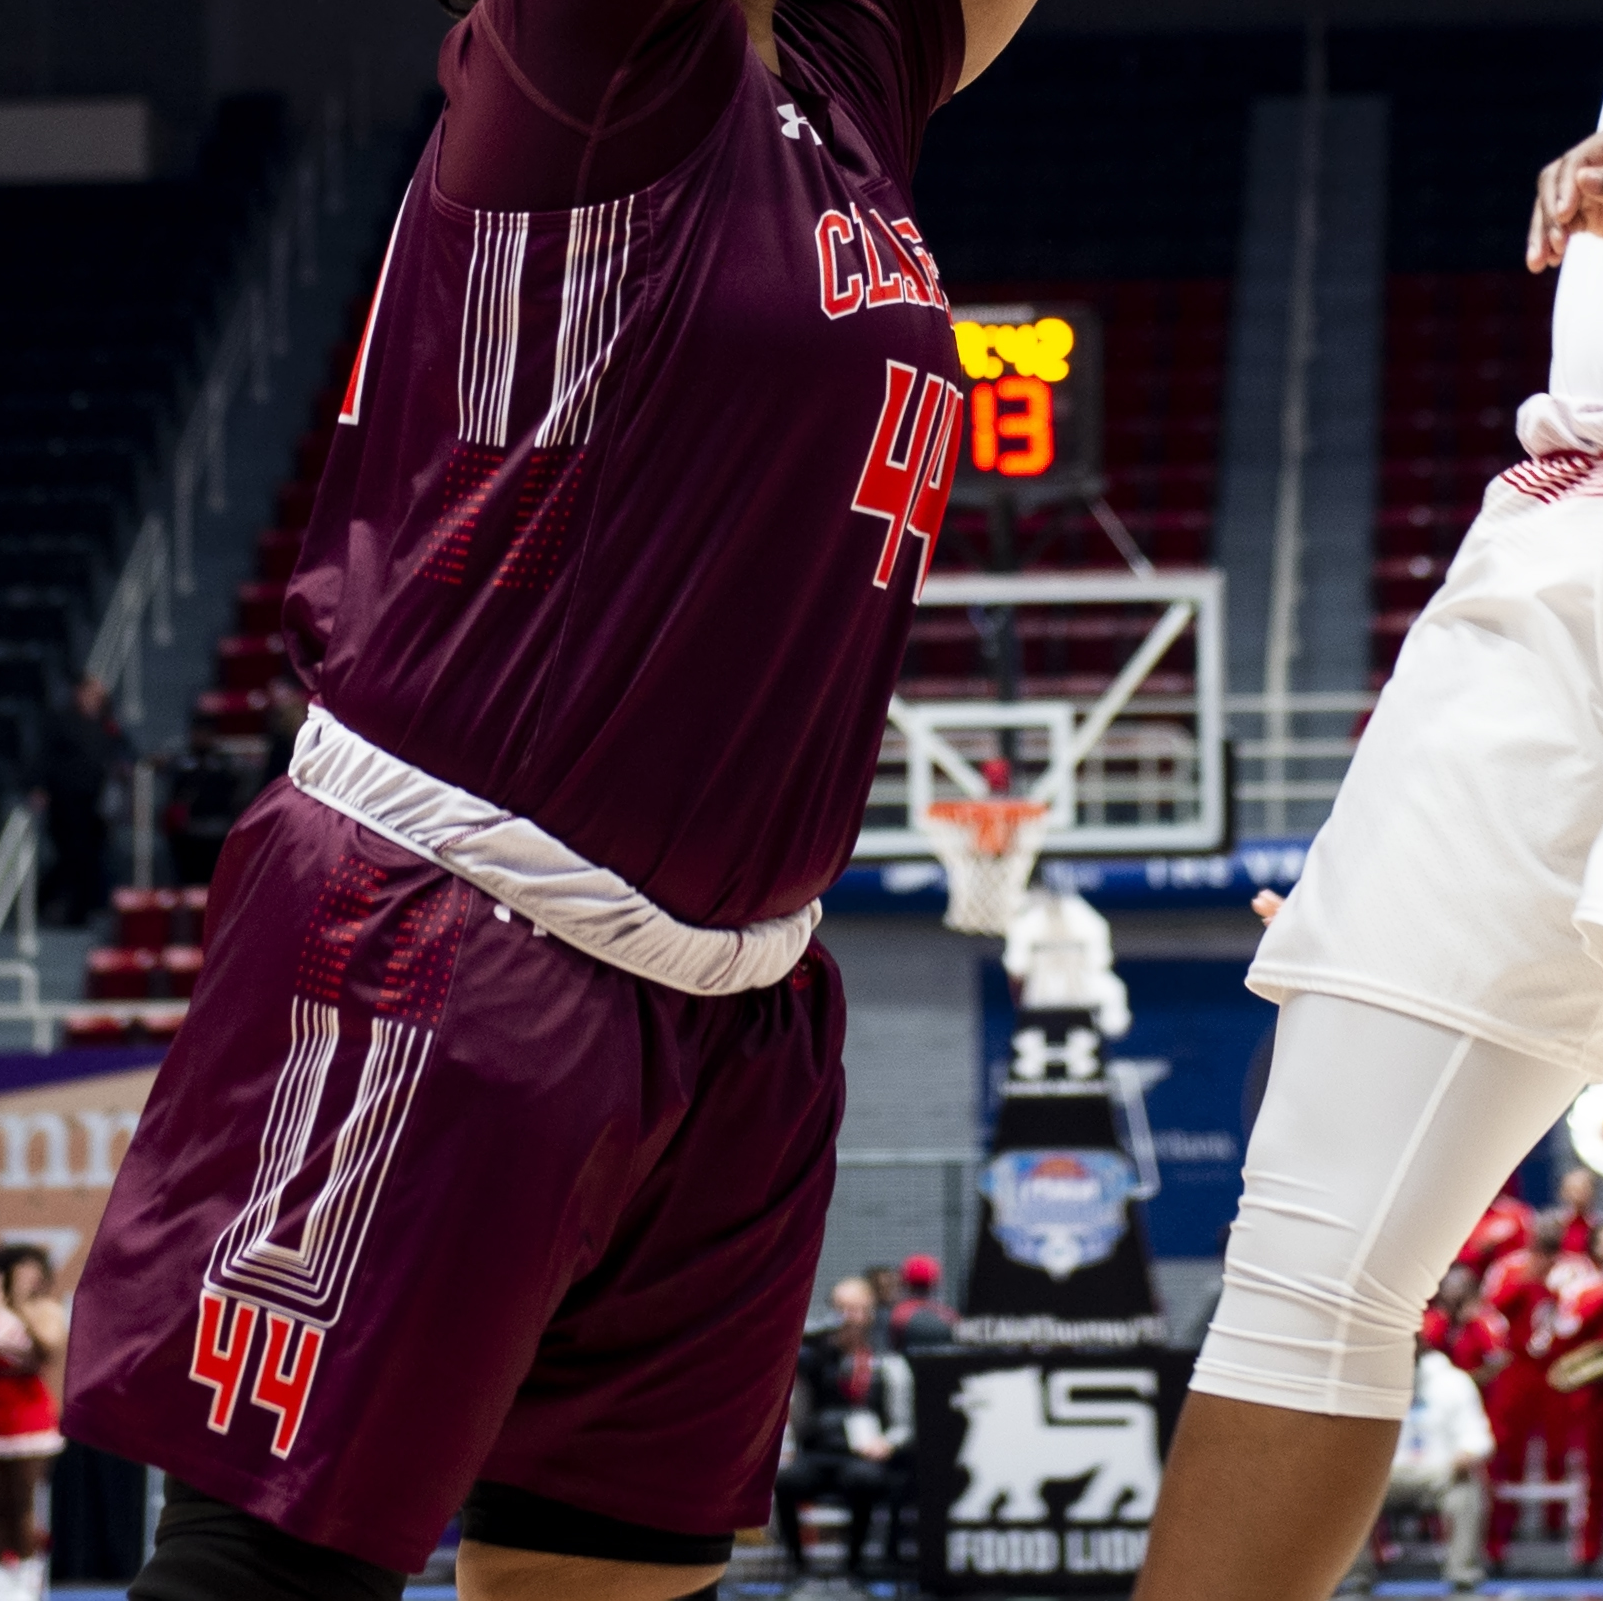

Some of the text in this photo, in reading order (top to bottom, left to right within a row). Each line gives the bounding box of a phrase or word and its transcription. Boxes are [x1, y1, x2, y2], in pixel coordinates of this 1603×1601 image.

[850, 358, 964, 606] 44
[971, 375, 1055, 477] 13
[188, 1286, 326, 1461] 44
[947, 1529, 1061, 1576] FOOD
